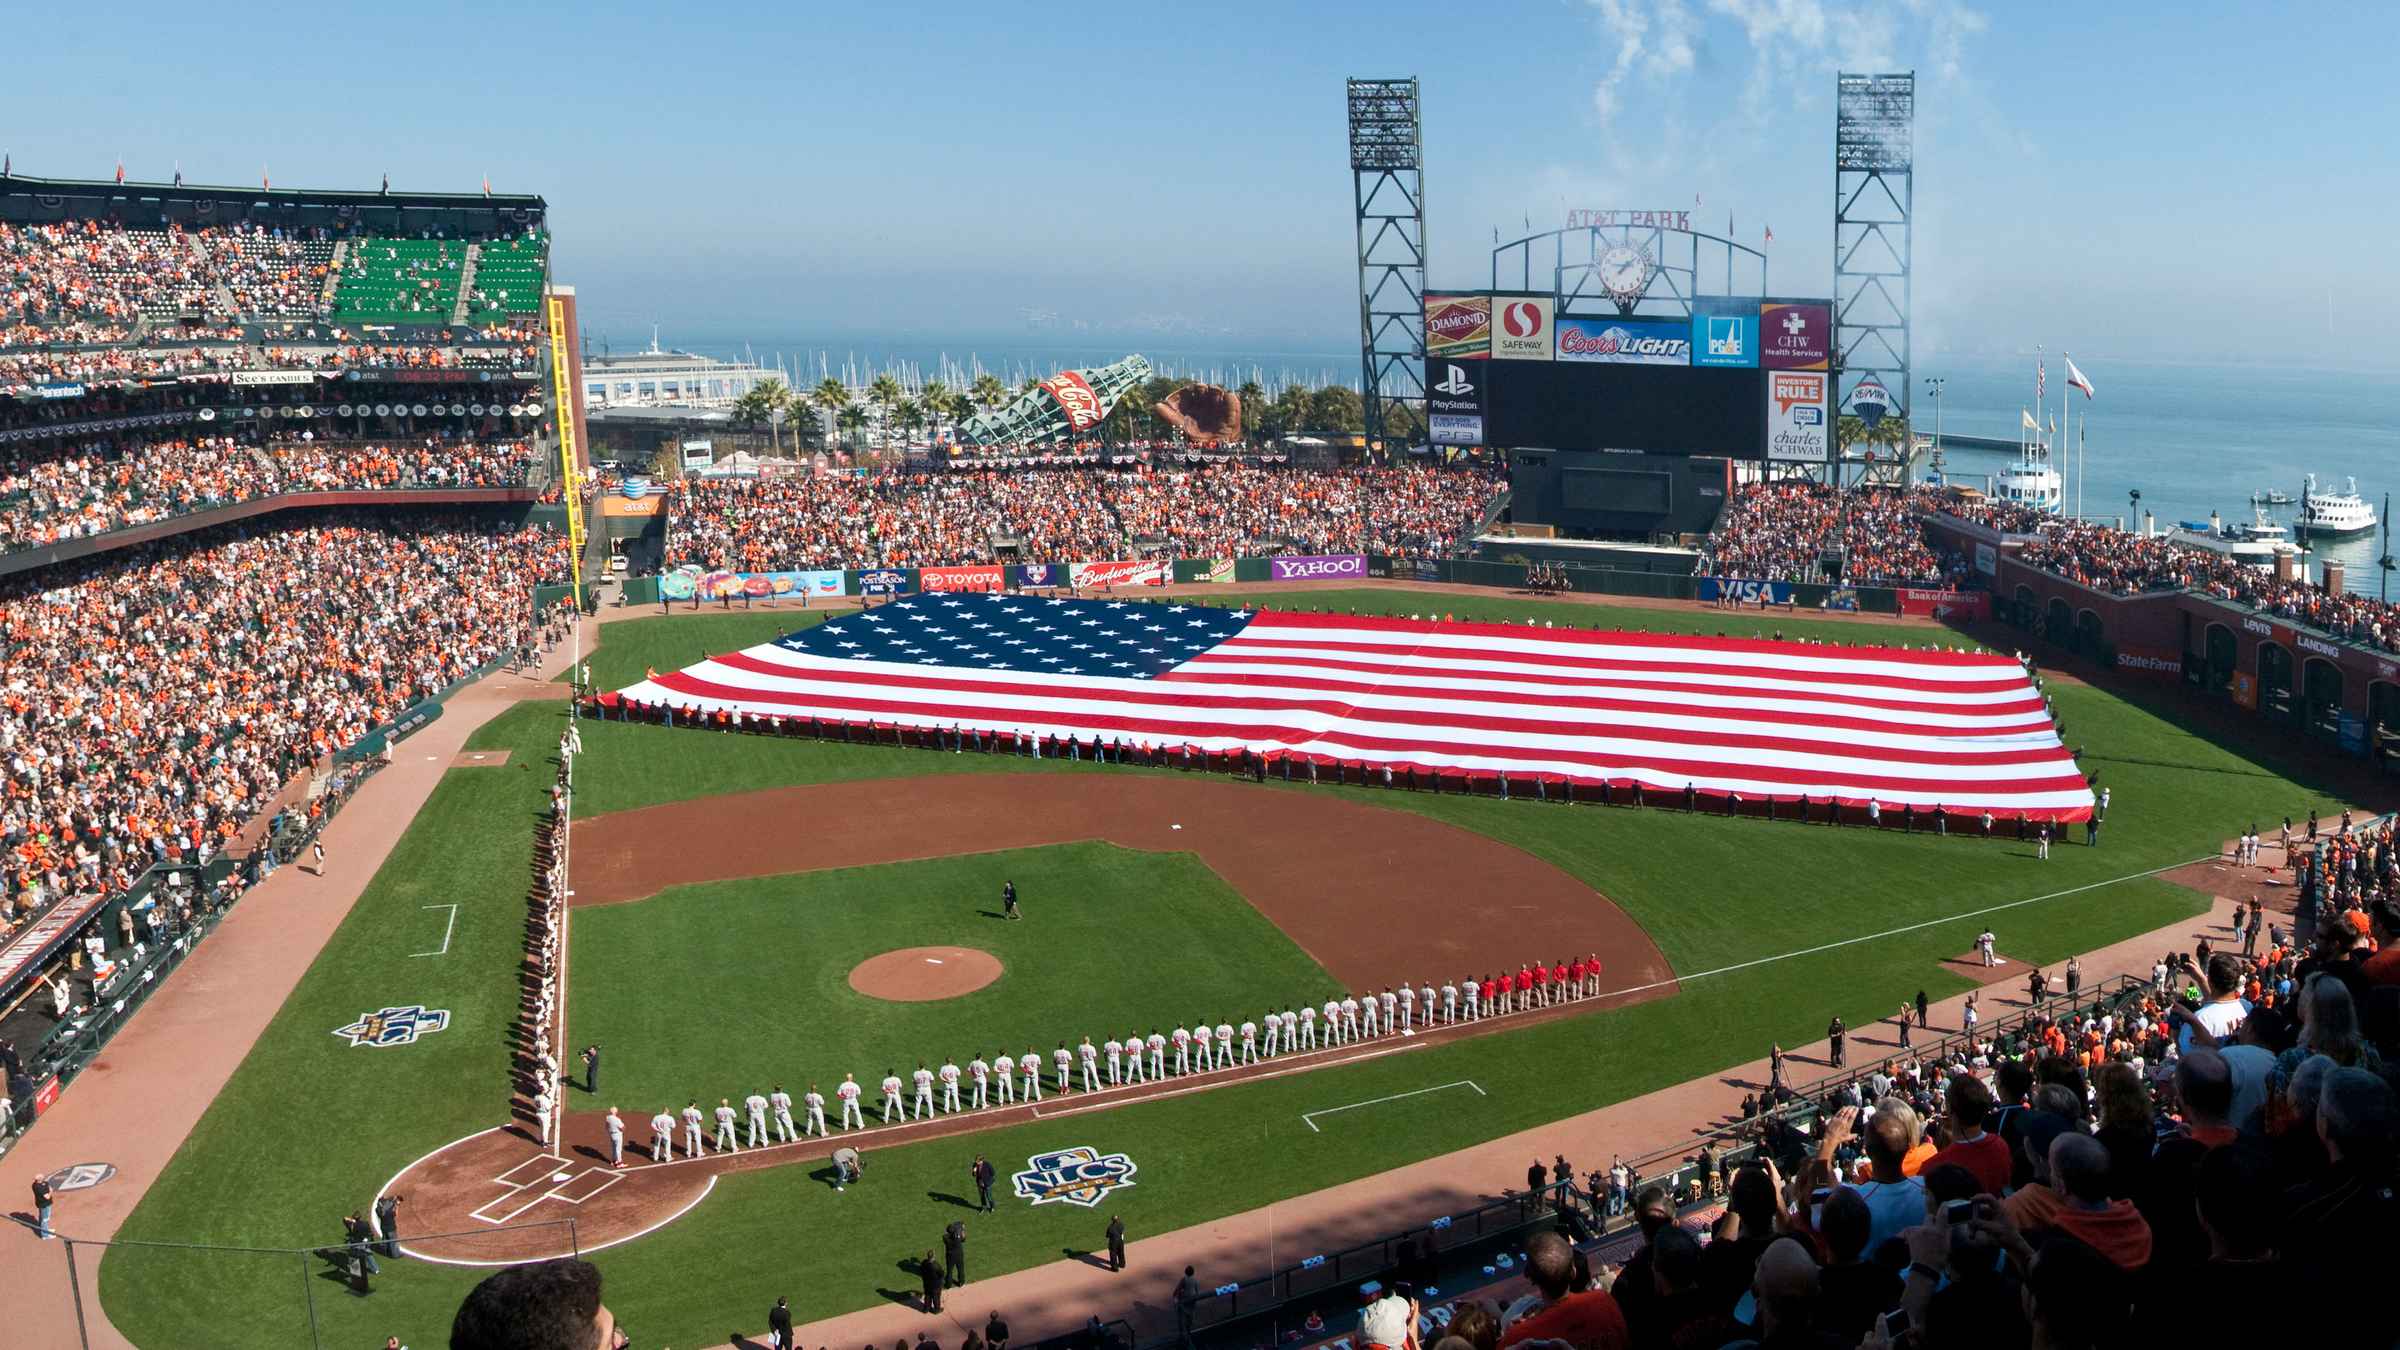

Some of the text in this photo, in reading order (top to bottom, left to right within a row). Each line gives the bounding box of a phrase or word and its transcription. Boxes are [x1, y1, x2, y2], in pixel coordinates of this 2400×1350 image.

[1567, 210, 1689, 231] AT&T PARK
[1431, 312, 1486, 331] DIAMOND
[1502, 340, 1542, 350] SAFEWAY
[1560, 327, 1686, 355] Coors LIGHT
[1778, 336, 1808, 348] CHW
[1765, 349, 1823, 358] Health Services
[236, 373, 267, 383] See's
[1777, 385, 1819, 399] RULE
[1432, 400, 1477, 411] PlayStation
[1774, 430, 1821, 445] charles
[1774, 445, 1822, 456] SCHWAB
[1079, 561, 1160, 586] Budweiser
[1275, 558, 1362, 578] YAHOO!
[945, 573, 1001, 585] TOYOTA
[1719, 580, 1775, 604] VISA
[1908, 590, 1931, 600] Bank
[1942, 591, 1979, 603] America
[2297, 635, 2339, 658] LANDING
[1017, 1157, 1132, 1195] NLCS
